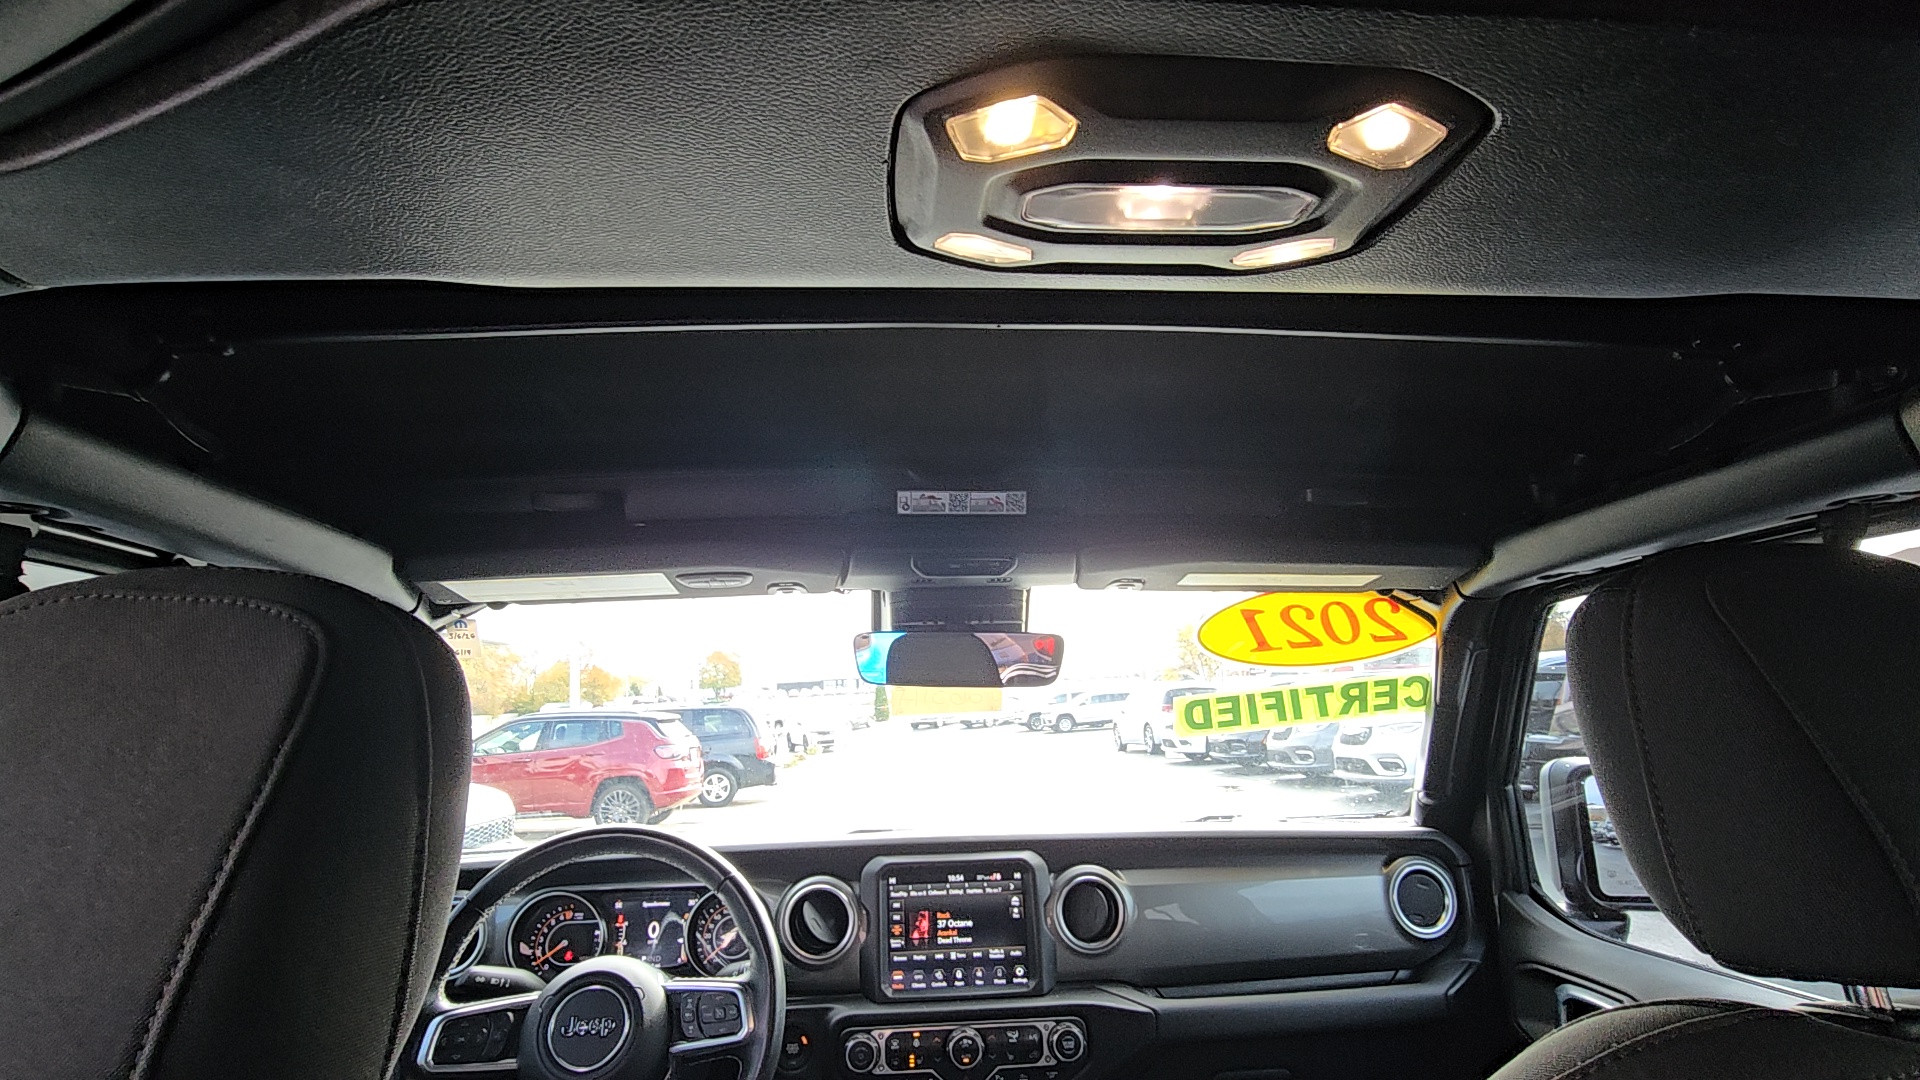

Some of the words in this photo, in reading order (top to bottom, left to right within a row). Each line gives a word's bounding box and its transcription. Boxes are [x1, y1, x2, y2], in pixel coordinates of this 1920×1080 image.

[947, 874, 965, 882] 10:54
[937, 919, 947, 929] 37
[947, 919, 973, 928] Octane
[647, 921, 660, 939] 0
[937, 936, 953, 944] Dead
[560, 1016, 617, 1037] Jeep
